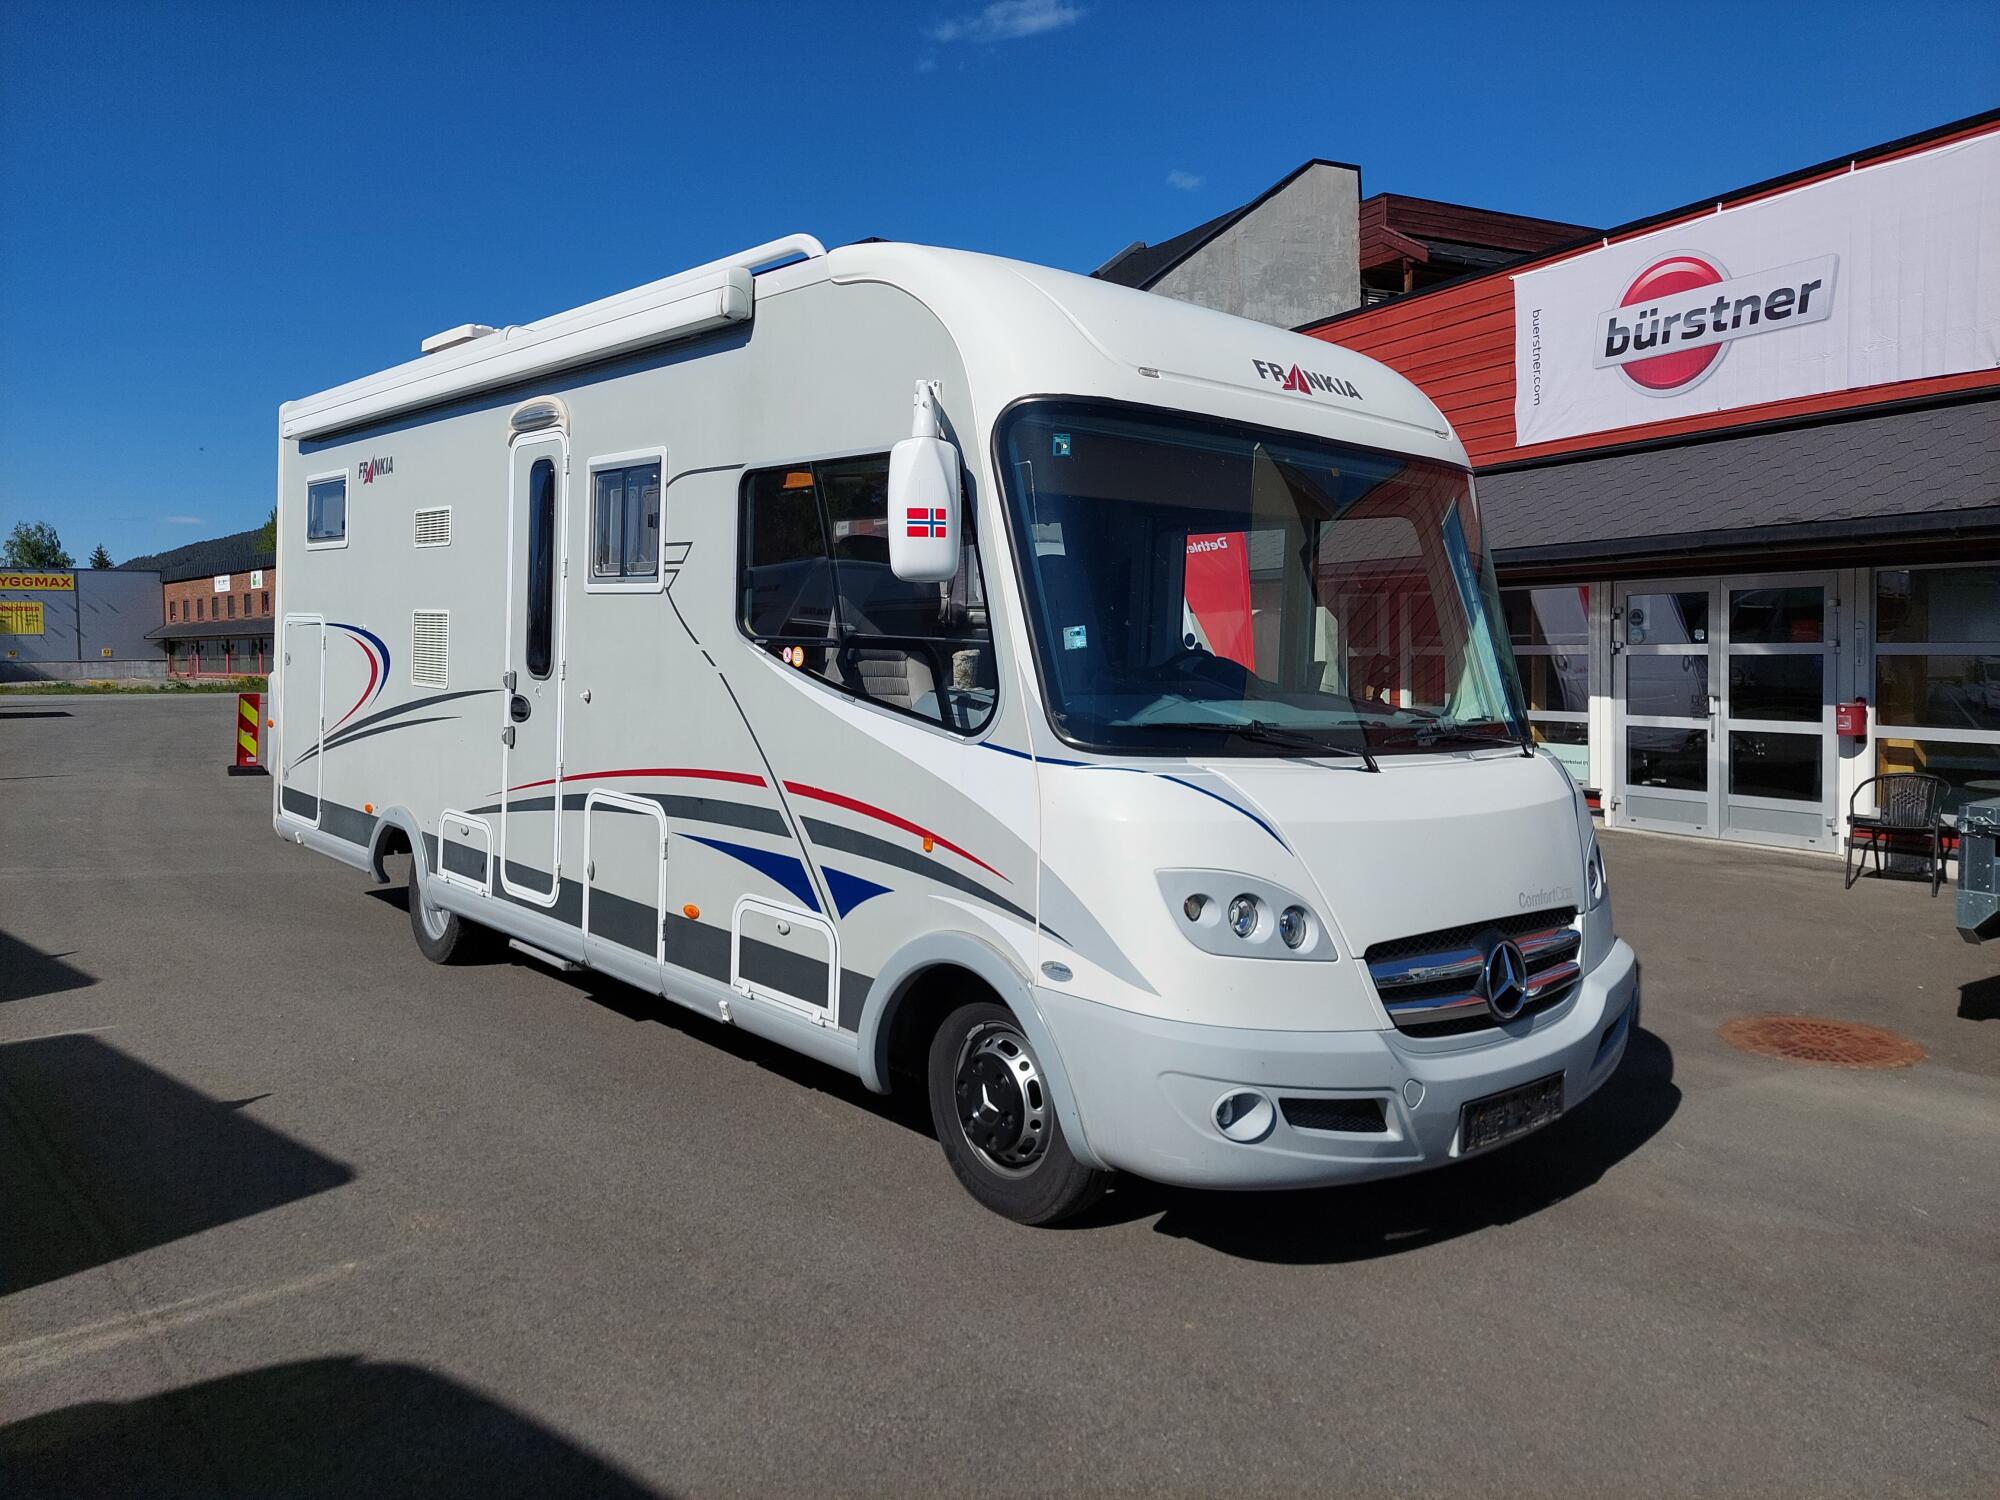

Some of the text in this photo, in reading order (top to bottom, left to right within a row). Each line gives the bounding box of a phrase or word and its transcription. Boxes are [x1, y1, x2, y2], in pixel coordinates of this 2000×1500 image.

[1605, 279, 1822, 357] bürstner
[1532, 308, 1542, 406] buerstner.com
[1251, 359, 1364, 400] FRANKIA
[358, 453, 393, 485] FRANKIA
[0, 576, 71, 587] YGGMAX
